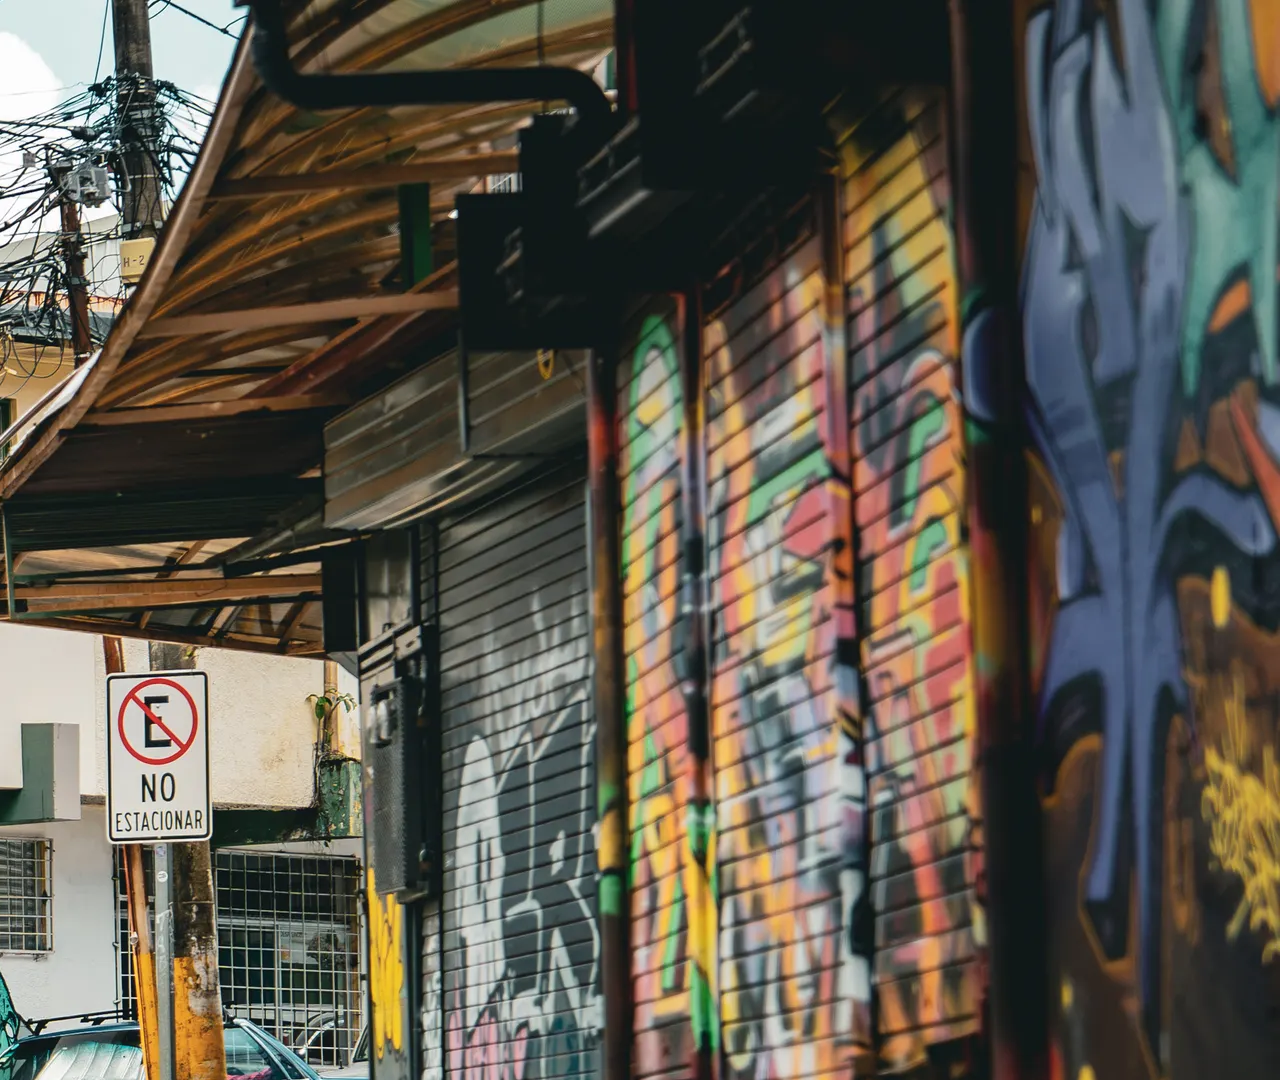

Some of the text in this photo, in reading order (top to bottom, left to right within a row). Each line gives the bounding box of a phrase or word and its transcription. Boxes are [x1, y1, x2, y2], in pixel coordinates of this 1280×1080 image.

[144, 696, 172, 748] E
[142, 773, 175, 802] NO
[116, 810, 203, 832] ESTACIONAR
